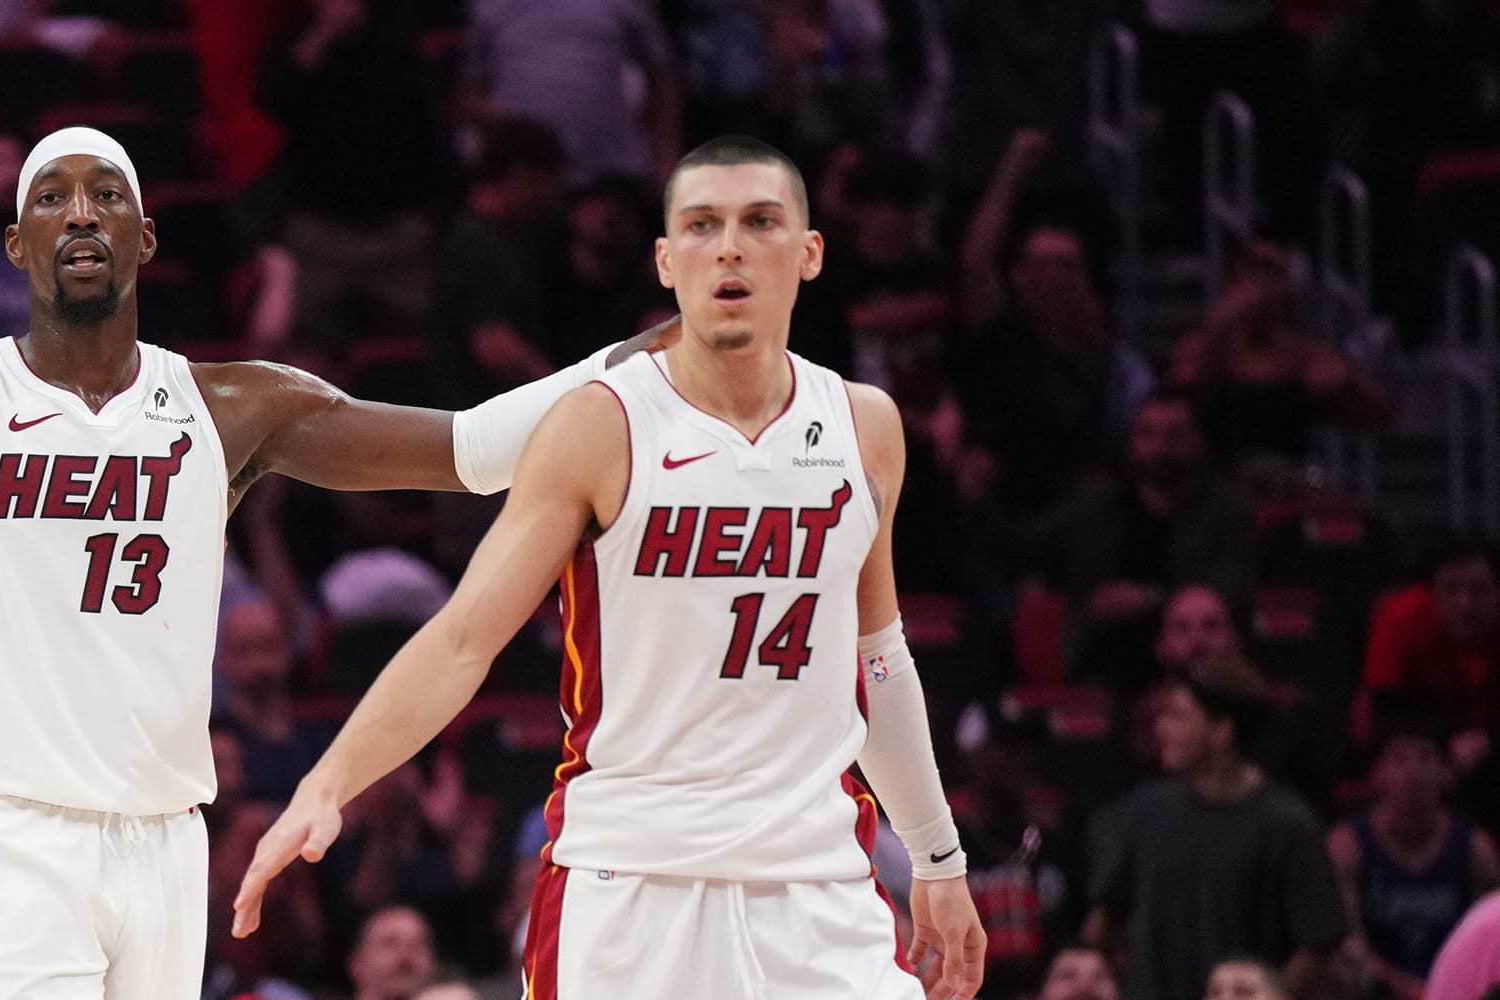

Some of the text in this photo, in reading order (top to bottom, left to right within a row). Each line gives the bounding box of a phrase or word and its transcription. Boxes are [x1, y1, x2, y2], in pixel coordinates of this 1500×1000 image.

[144, 411, 196, 425] Robinhood
[792, 457, 845, 468] Robinhood
[633, 478, 853, 578] HEAT
[80, 532, 170, 615] 13
[719, 592, 820, 681] 14
